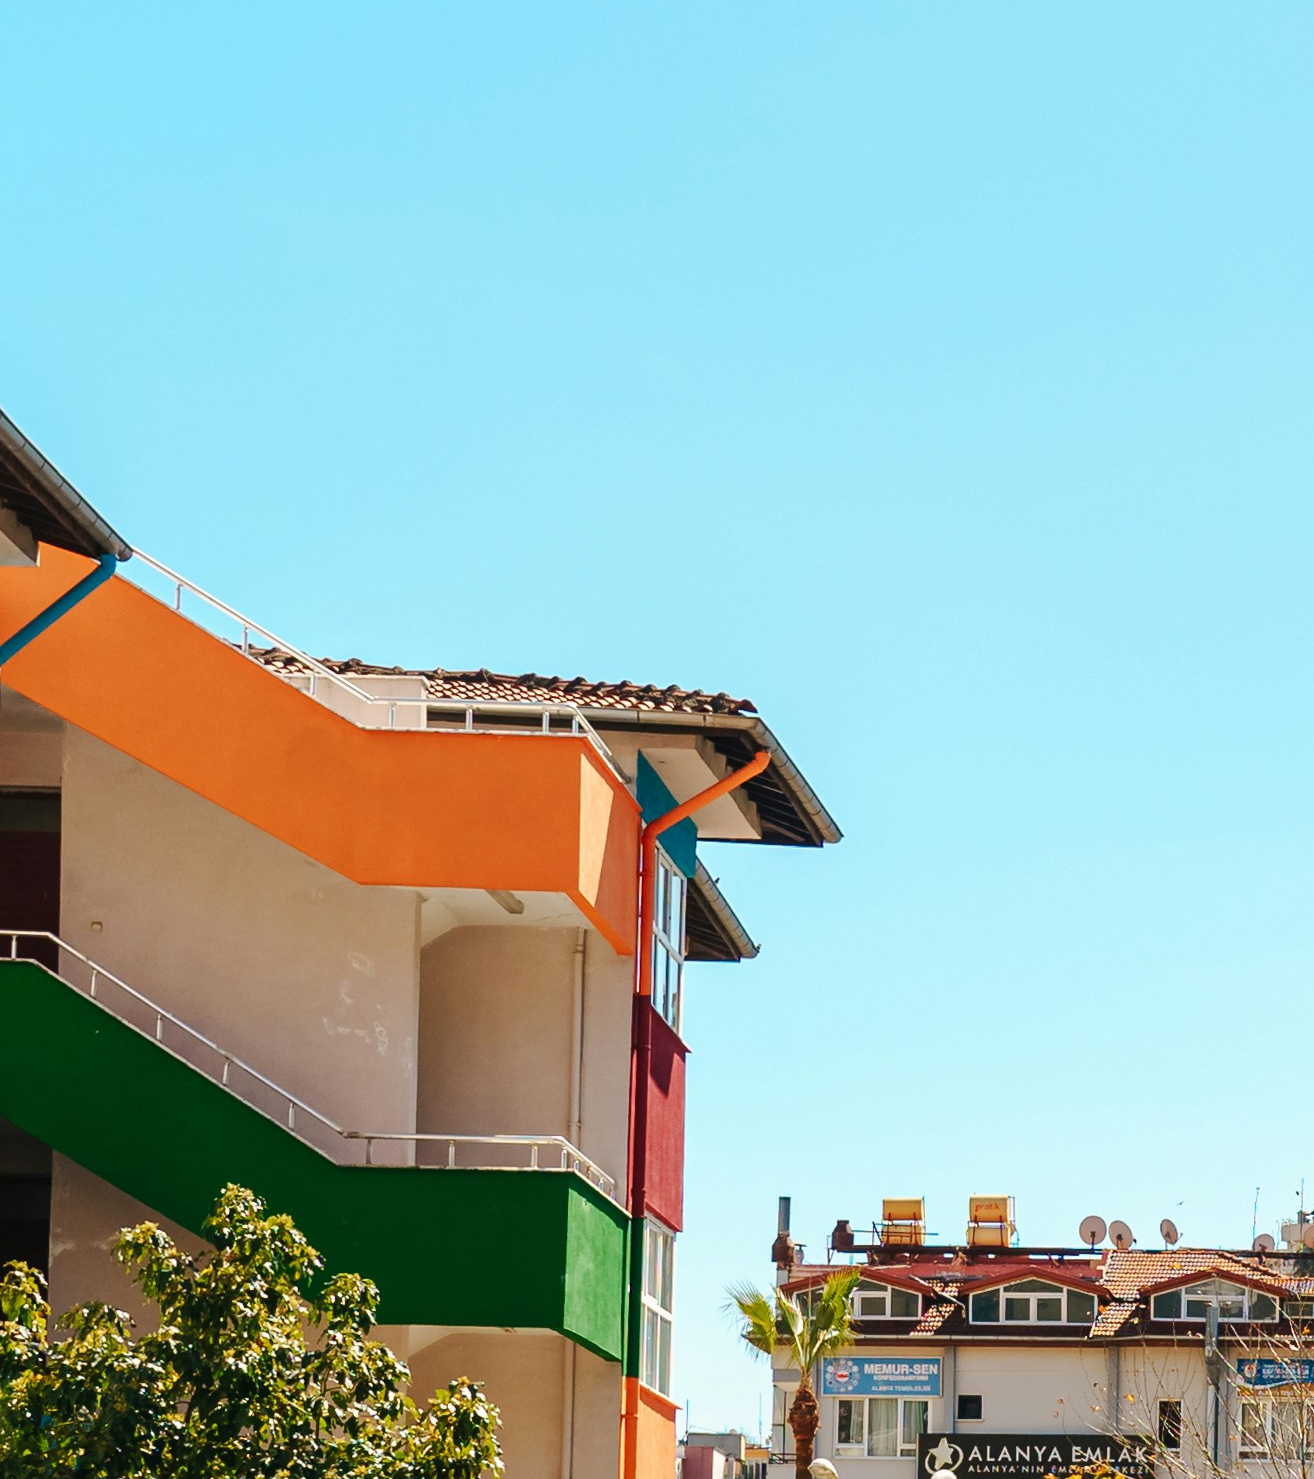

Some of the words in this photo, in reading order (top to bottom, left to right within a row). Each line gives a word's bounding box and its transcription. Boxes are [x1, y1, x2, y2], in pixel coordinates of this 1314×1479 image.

[864, 1364, 938, 1375] MEMUR-SEN
[968, 1445, 1062, 1463] ALANYA
[1071, 1445, 1148, 1464] EMLAK
[968, 1465, 1045, 1474] ALANYA'NIN
